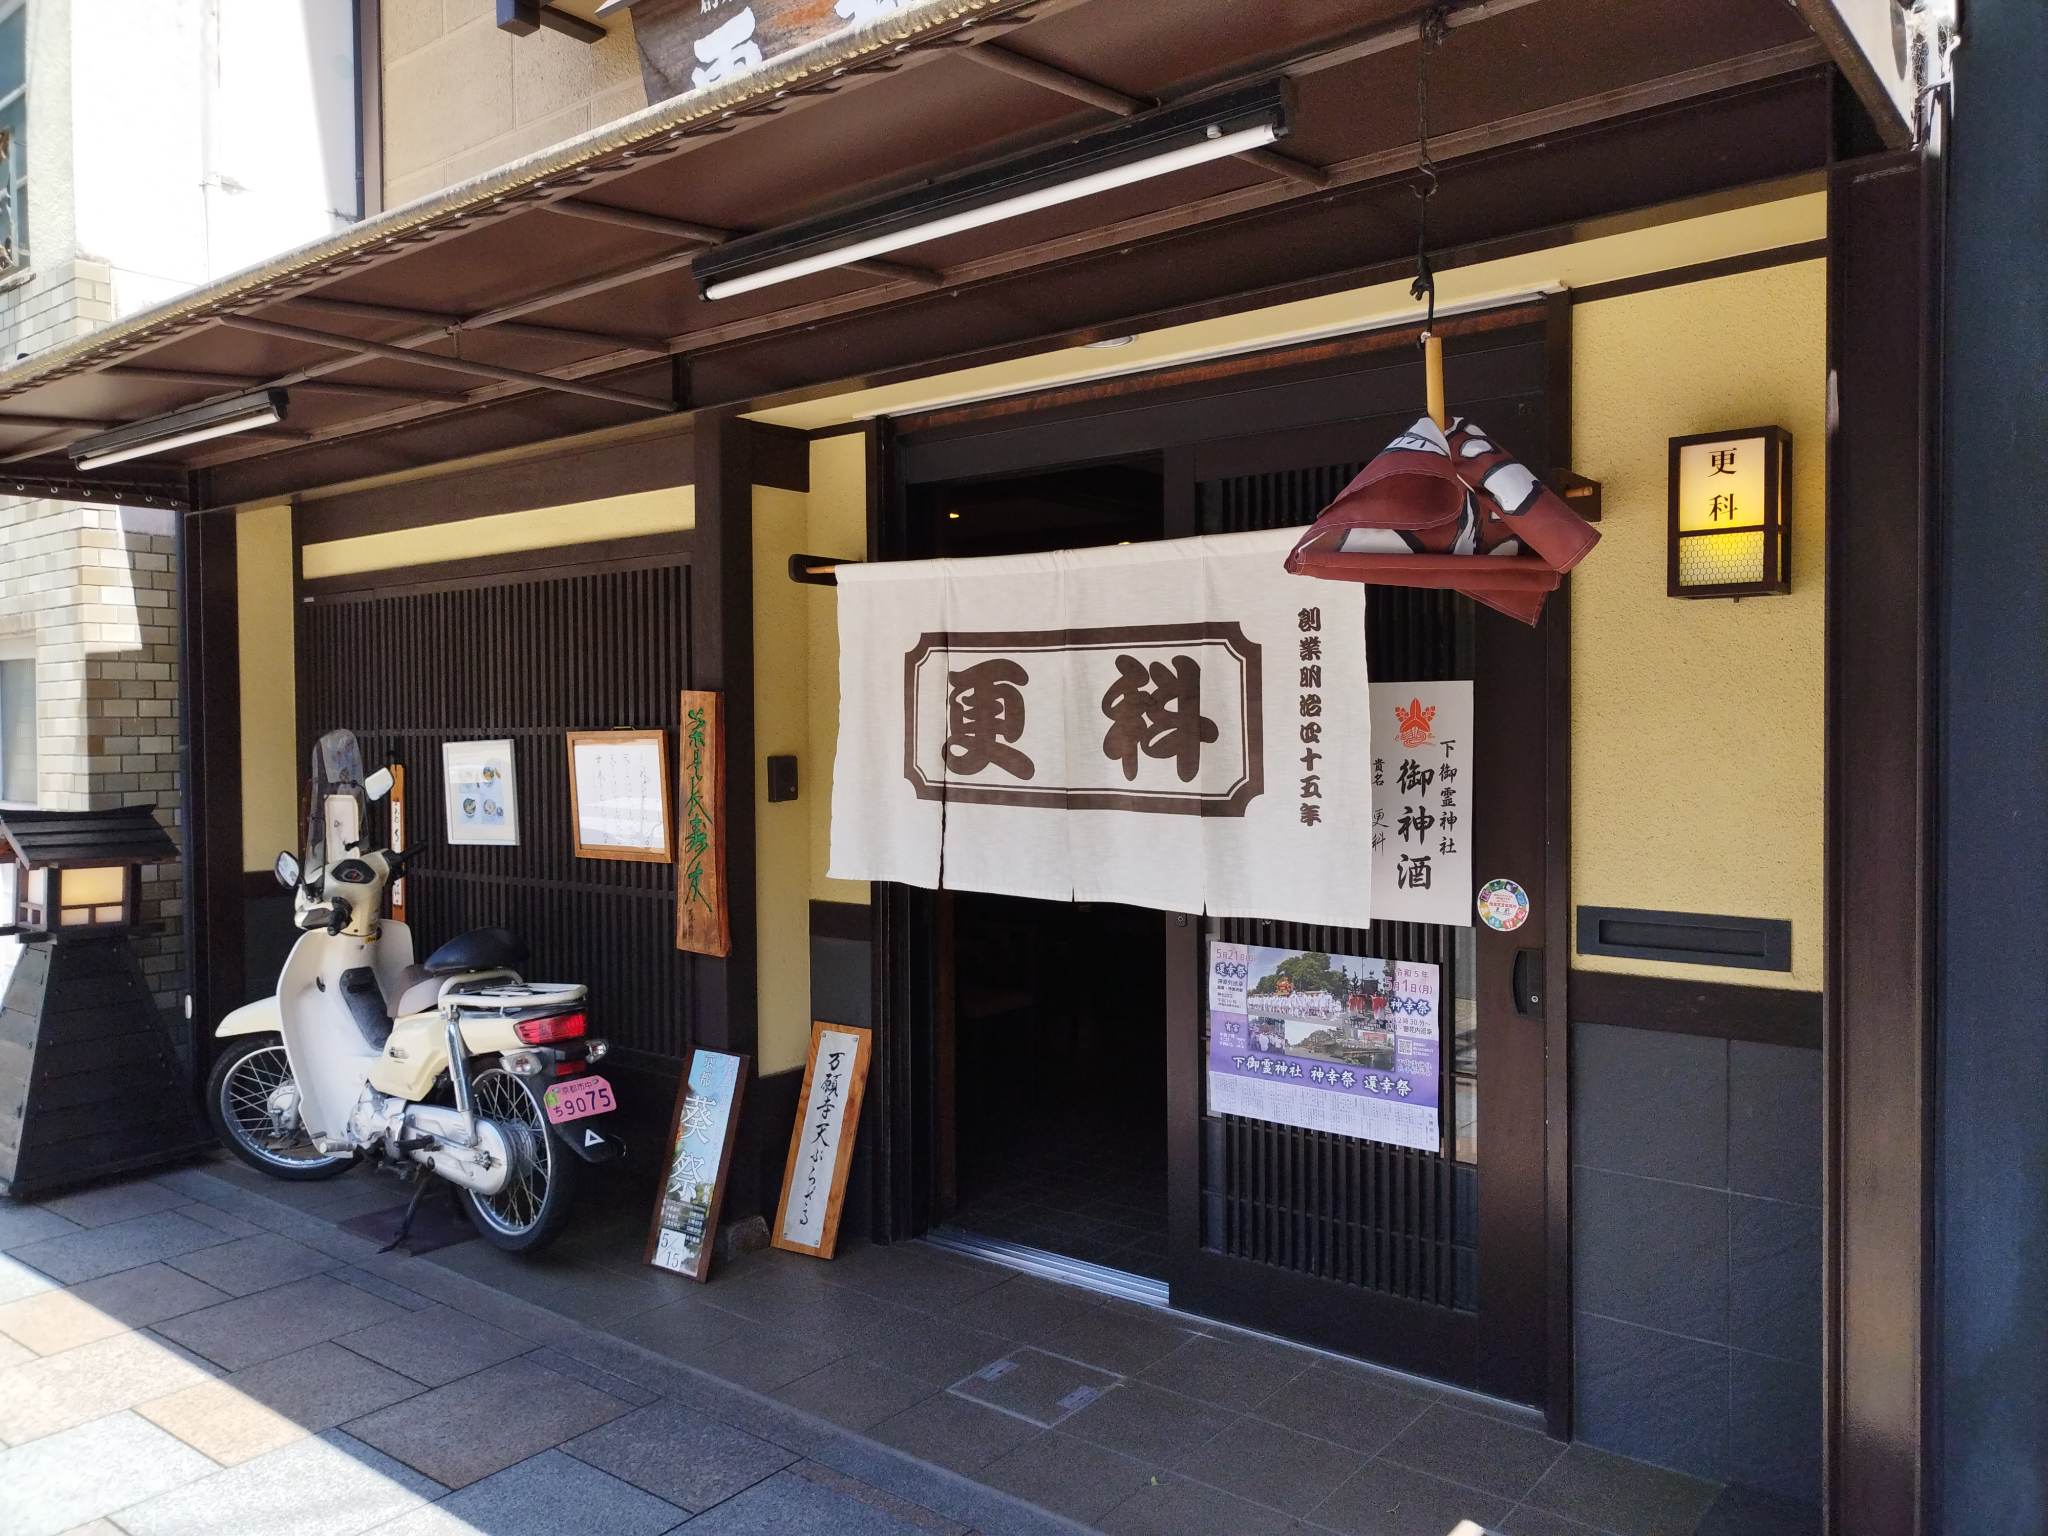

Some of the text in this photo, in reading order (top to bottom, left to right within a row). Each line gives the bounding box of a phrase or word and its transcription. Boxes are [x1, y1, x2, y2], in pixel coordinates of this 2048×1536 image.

[1707, 448, 1738, 521] 更科
[941, 654, 1219, 783] 更科
[1297, 607, 1323, 827] 創業明治四十五年
[1396, 758, 1435, 890] 御神酒
[1439, 740, 1457, 855] 下御霊神社
[1390, 998, 1431, 1016] 神幸祭
[1232, 1056, 1412, 1098] 下御霊神社 神幸祭 還幸祭
[669, 1094, 717, 1202] 葵祭
